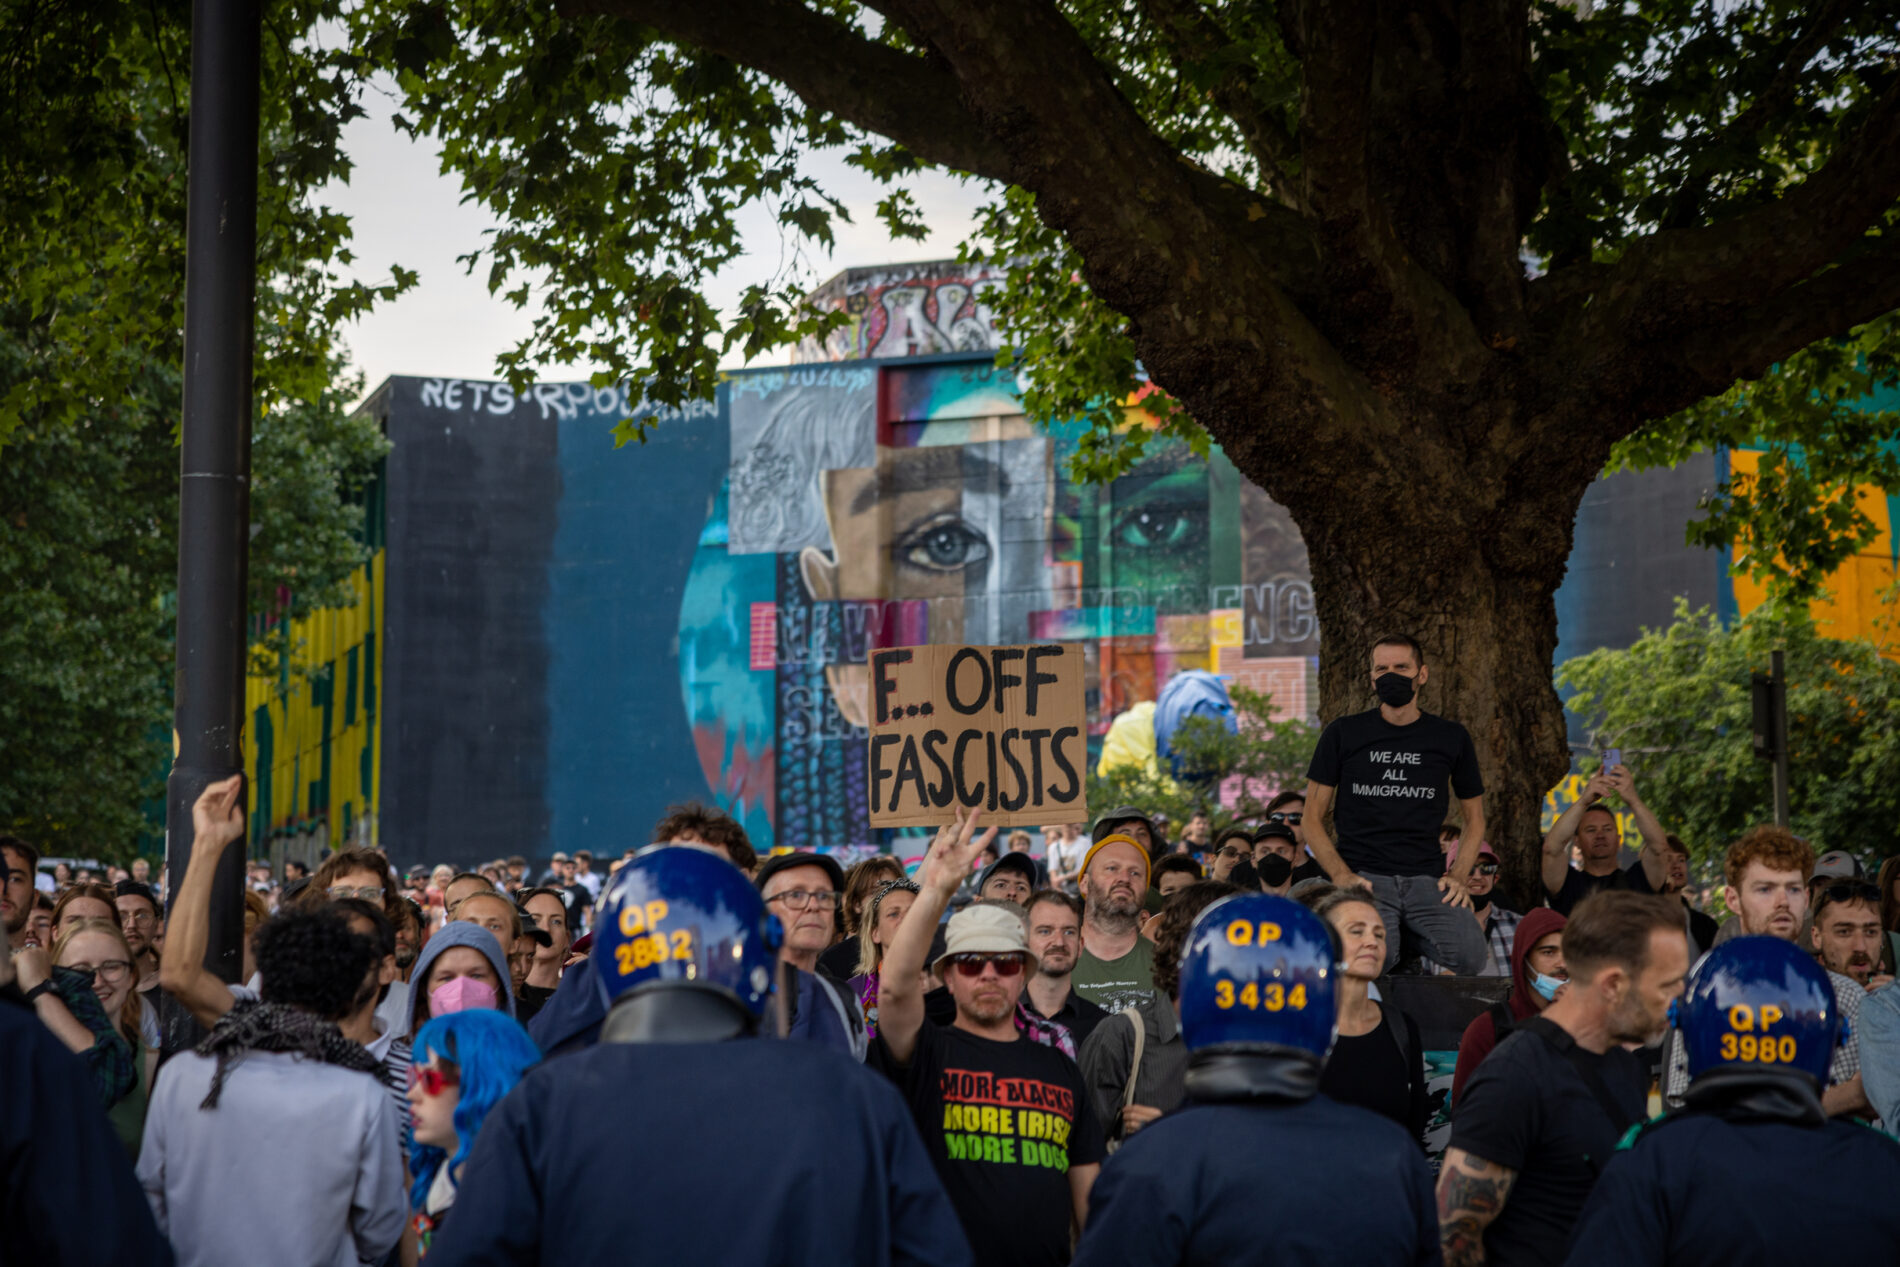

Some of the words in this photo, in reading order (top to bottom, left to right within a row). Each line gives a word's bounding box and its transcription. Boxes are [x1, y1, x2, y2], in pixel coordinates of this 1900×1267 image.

[945, 645, 1065, 717] OFF
[870, 726, 1080, 813] FASCISTS
[1369, 750, 1392, 764] WE
[1393, 752, 1422, 765] ARE
[1352, 782, 1436, 799] IMMIGRANTS
[1382, 768, 1408, 781] ALL
[614, 928, 694, 976] 2882
[1215, 979, 1309, 1012] 3434
[1720, 1033, 1797, 1063] 3980
[943, 1072, 1001, 1101] MORE
[1006, 1080, 1073, 1118] BLACKS
[943, 1103, 1015, 1135] MORE
[944, 1132, 1018, 1164] MORE
